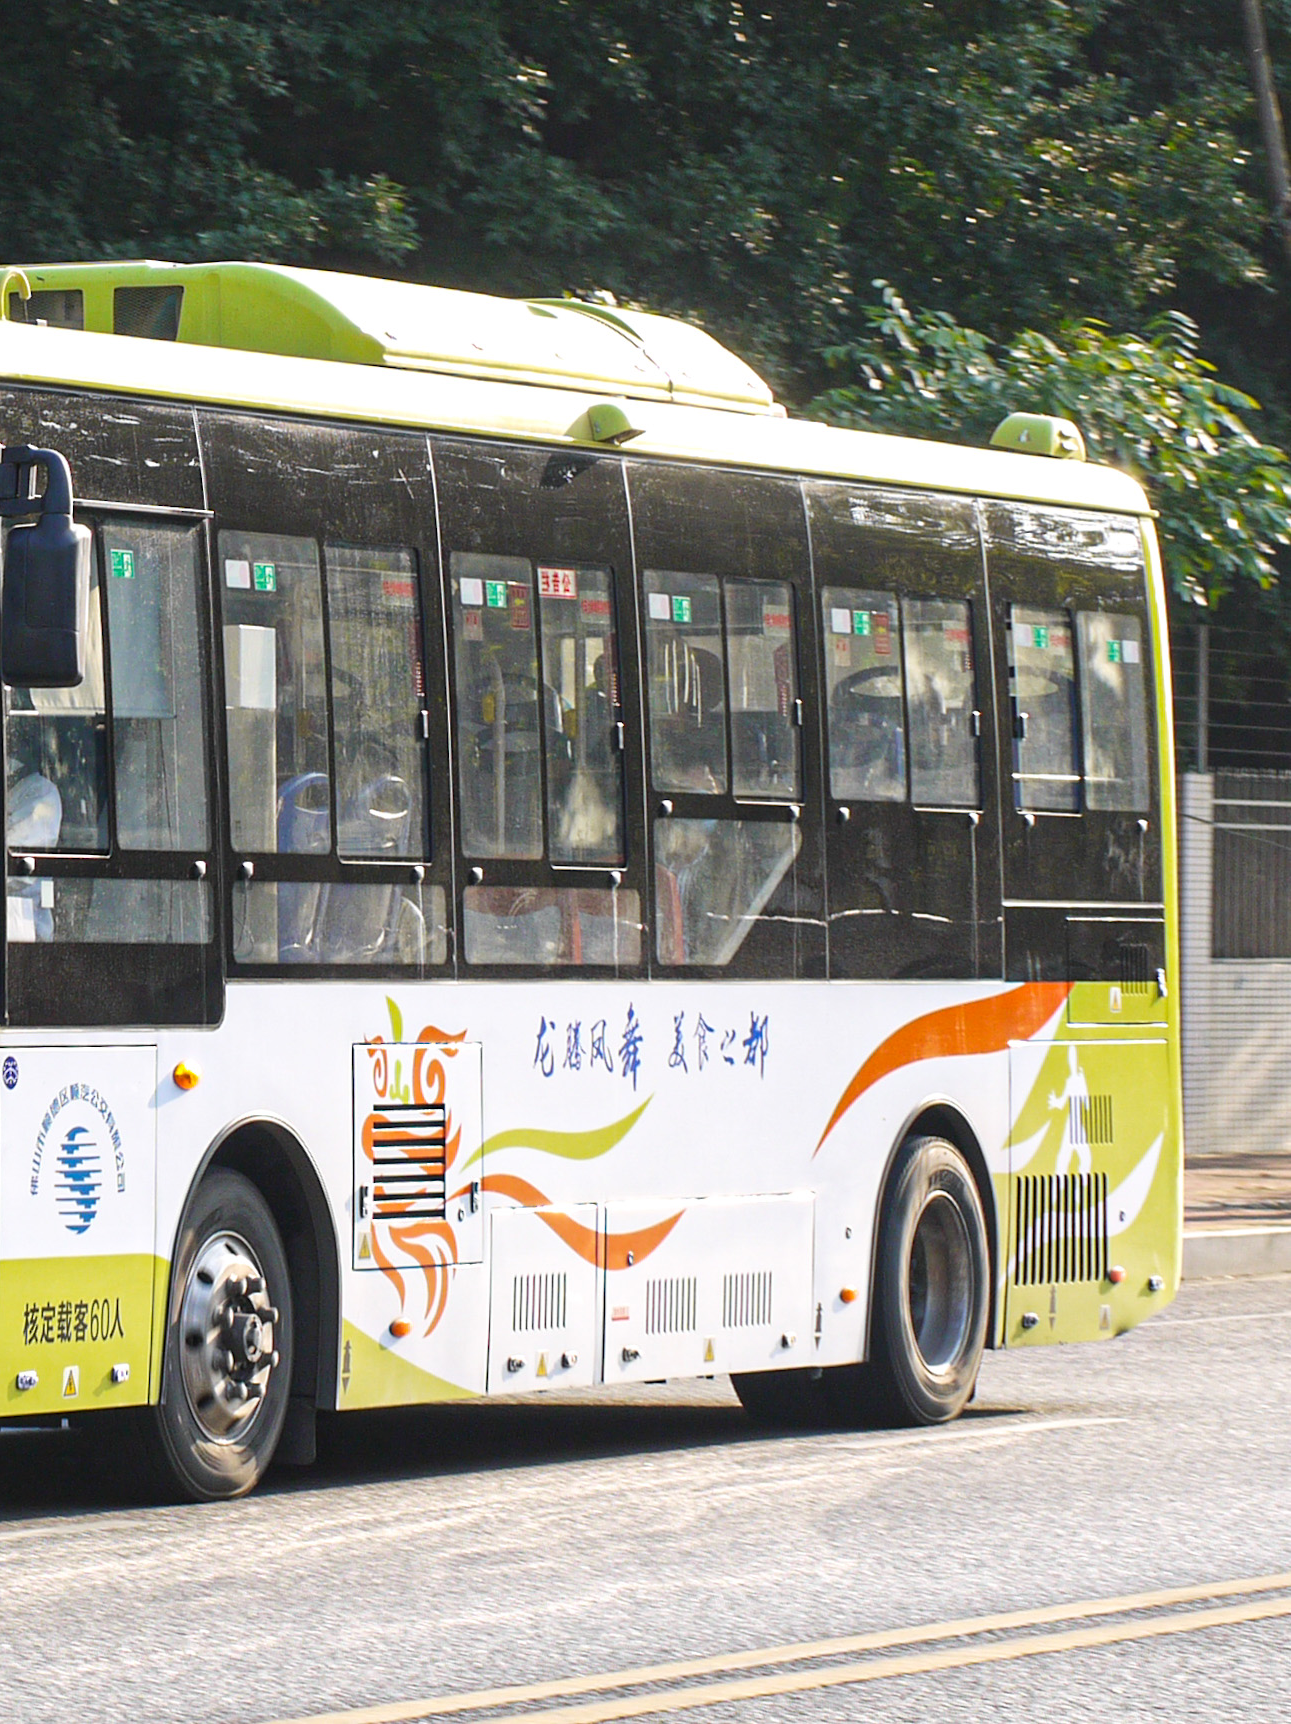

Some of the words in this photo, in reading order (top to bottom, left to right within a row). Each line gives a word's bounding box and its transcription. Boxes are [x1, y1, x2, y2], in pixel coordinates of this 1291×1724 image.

[533, 1002, 643, 1091] 龙腾凤舞
[668, 1010, 768, 1079] 美食之都
[23, 1297, 124, 1345] 核定载客60人
